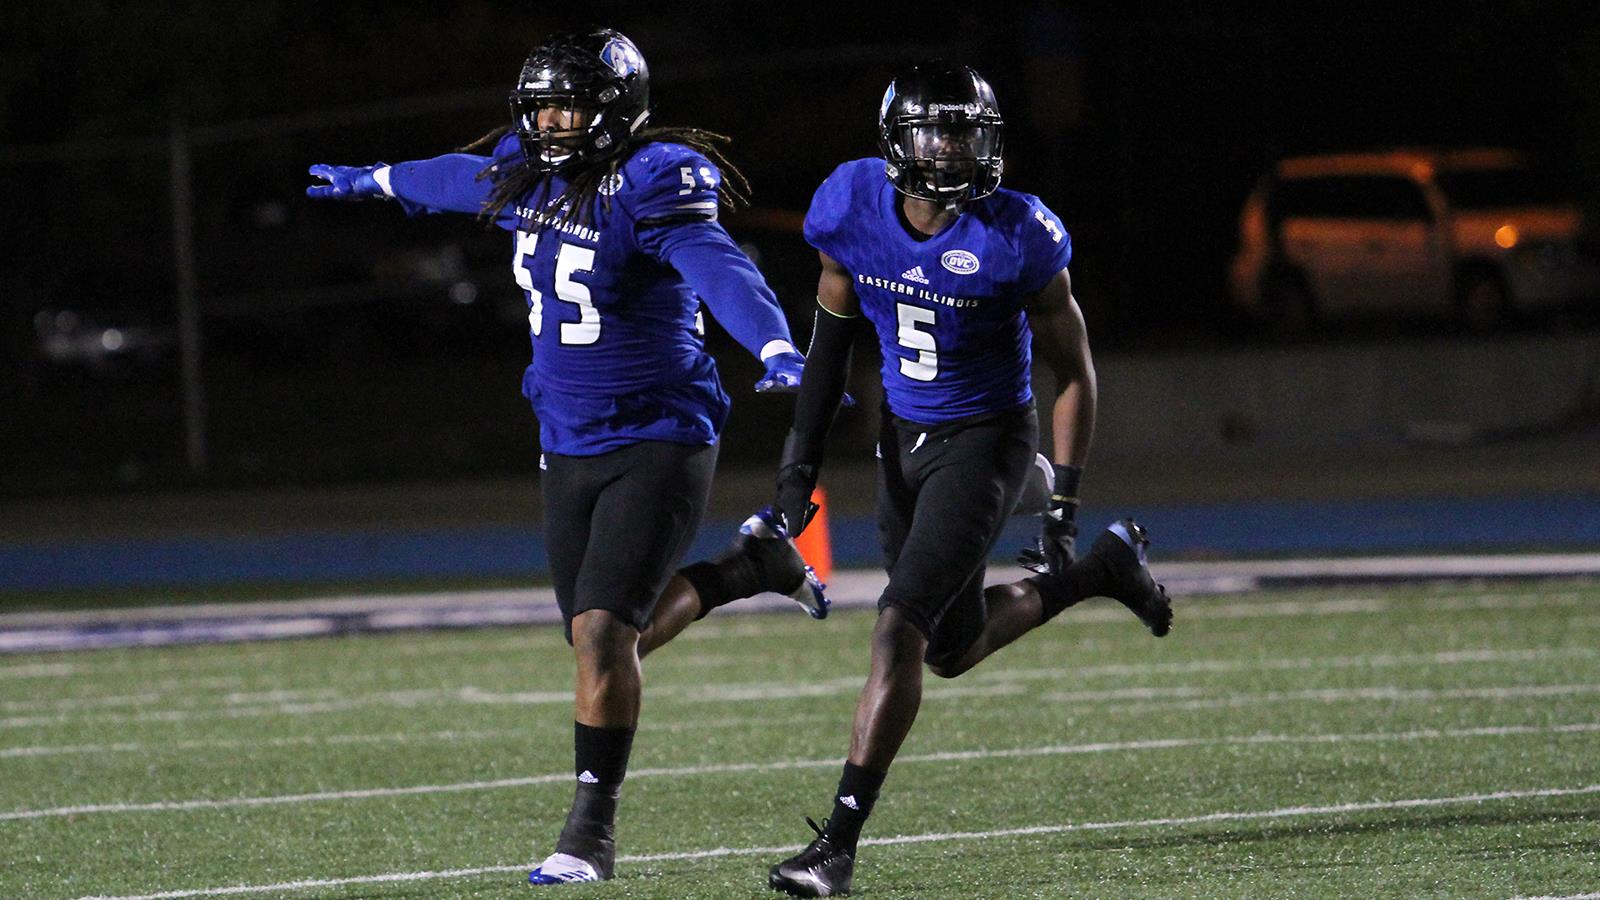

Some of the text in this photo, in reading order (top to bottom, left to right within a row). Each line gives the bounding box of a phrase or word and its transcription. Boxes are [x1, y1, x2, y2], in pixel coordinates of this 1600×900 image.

[1034, 209, 1063, 243] 5
[901, 272, 930, 285] adidas
[949, 256, 972, 269] OVC
[513, 229, 601, 345] 55
[858, 274, 979, 308] EASTERN ILLINOIS
[896, 302, 939, 382] 5
